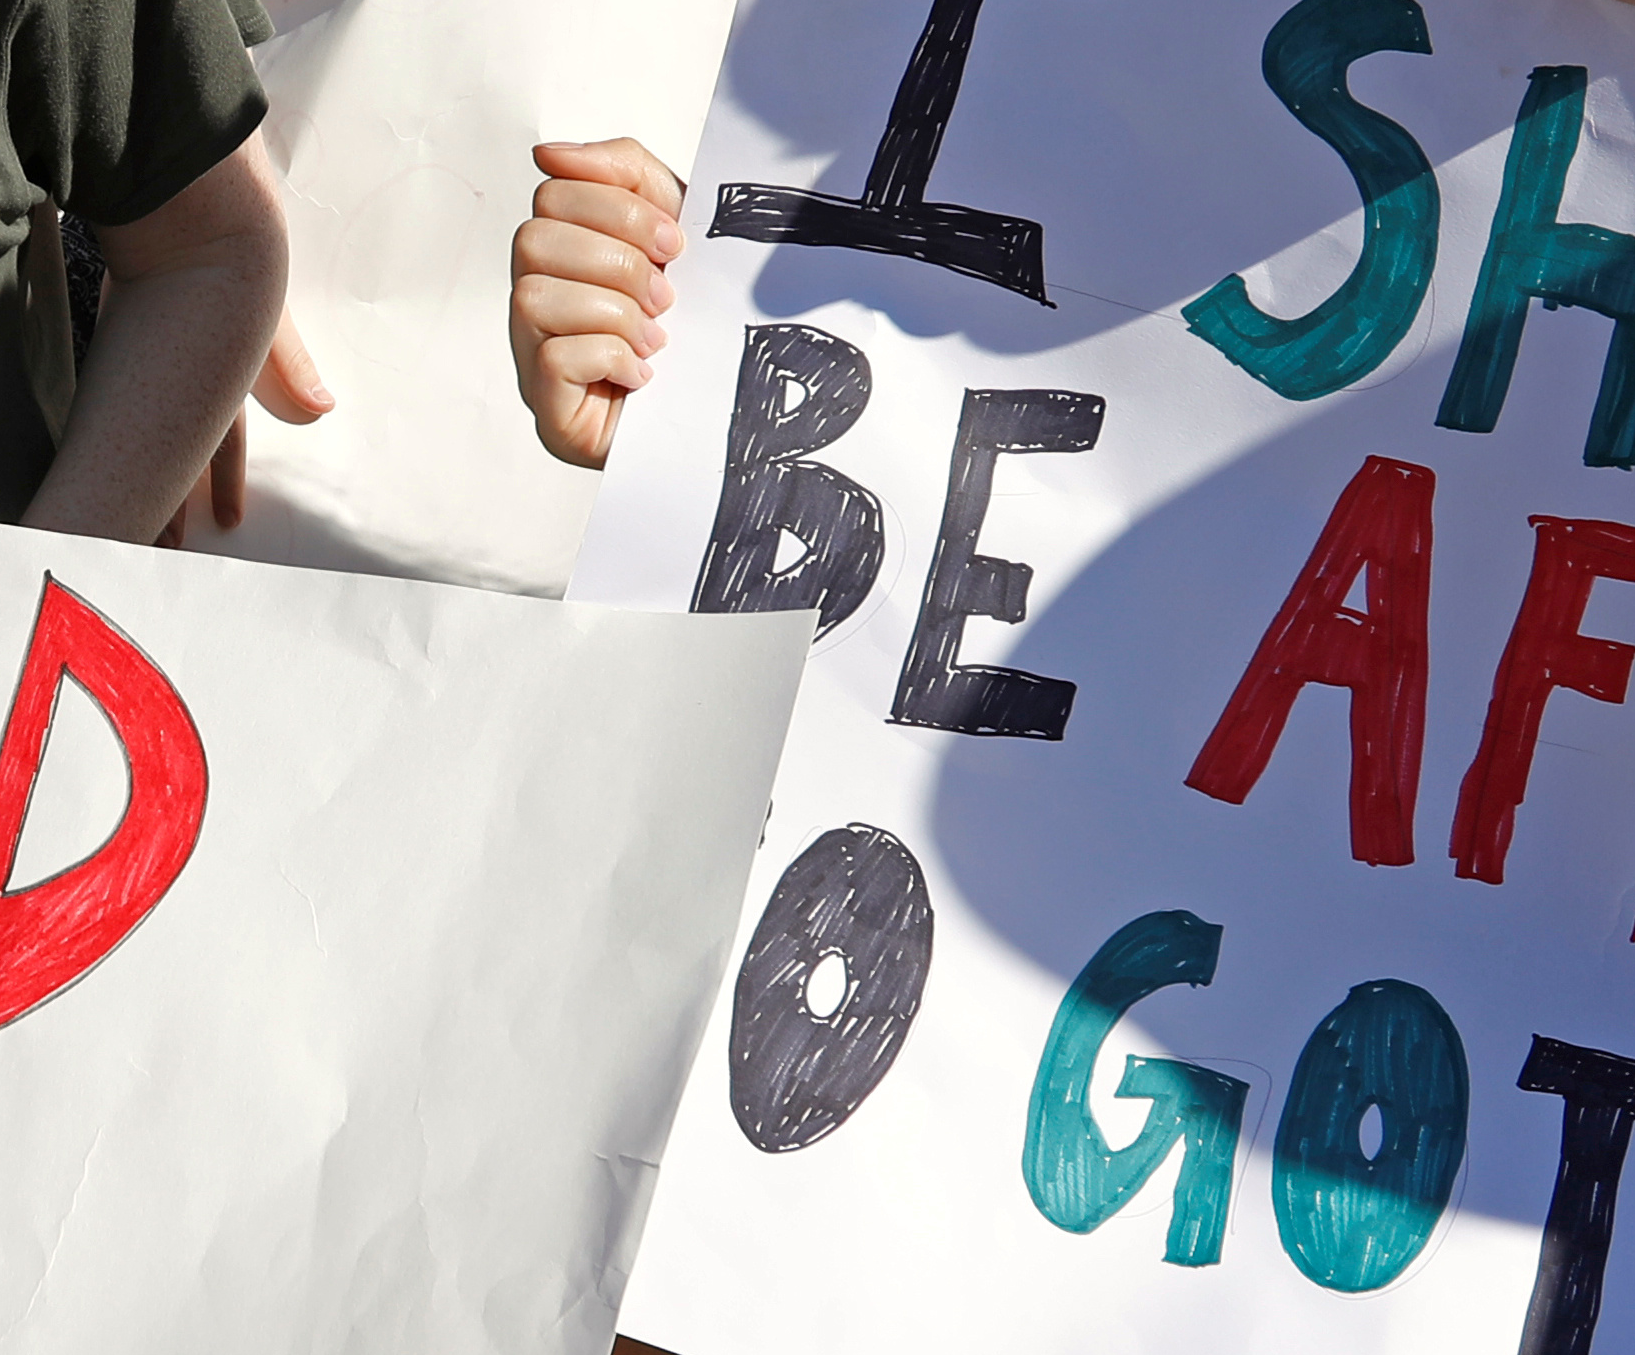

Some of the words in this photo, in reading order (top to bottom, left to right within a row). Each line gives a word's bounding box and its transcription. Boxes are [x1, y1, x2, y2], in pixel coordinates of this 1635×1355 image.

[690, 324, 1107, 742] BE
[729, 801, 935, 1155] O
[1020, 908, 1471, 1295] GO
